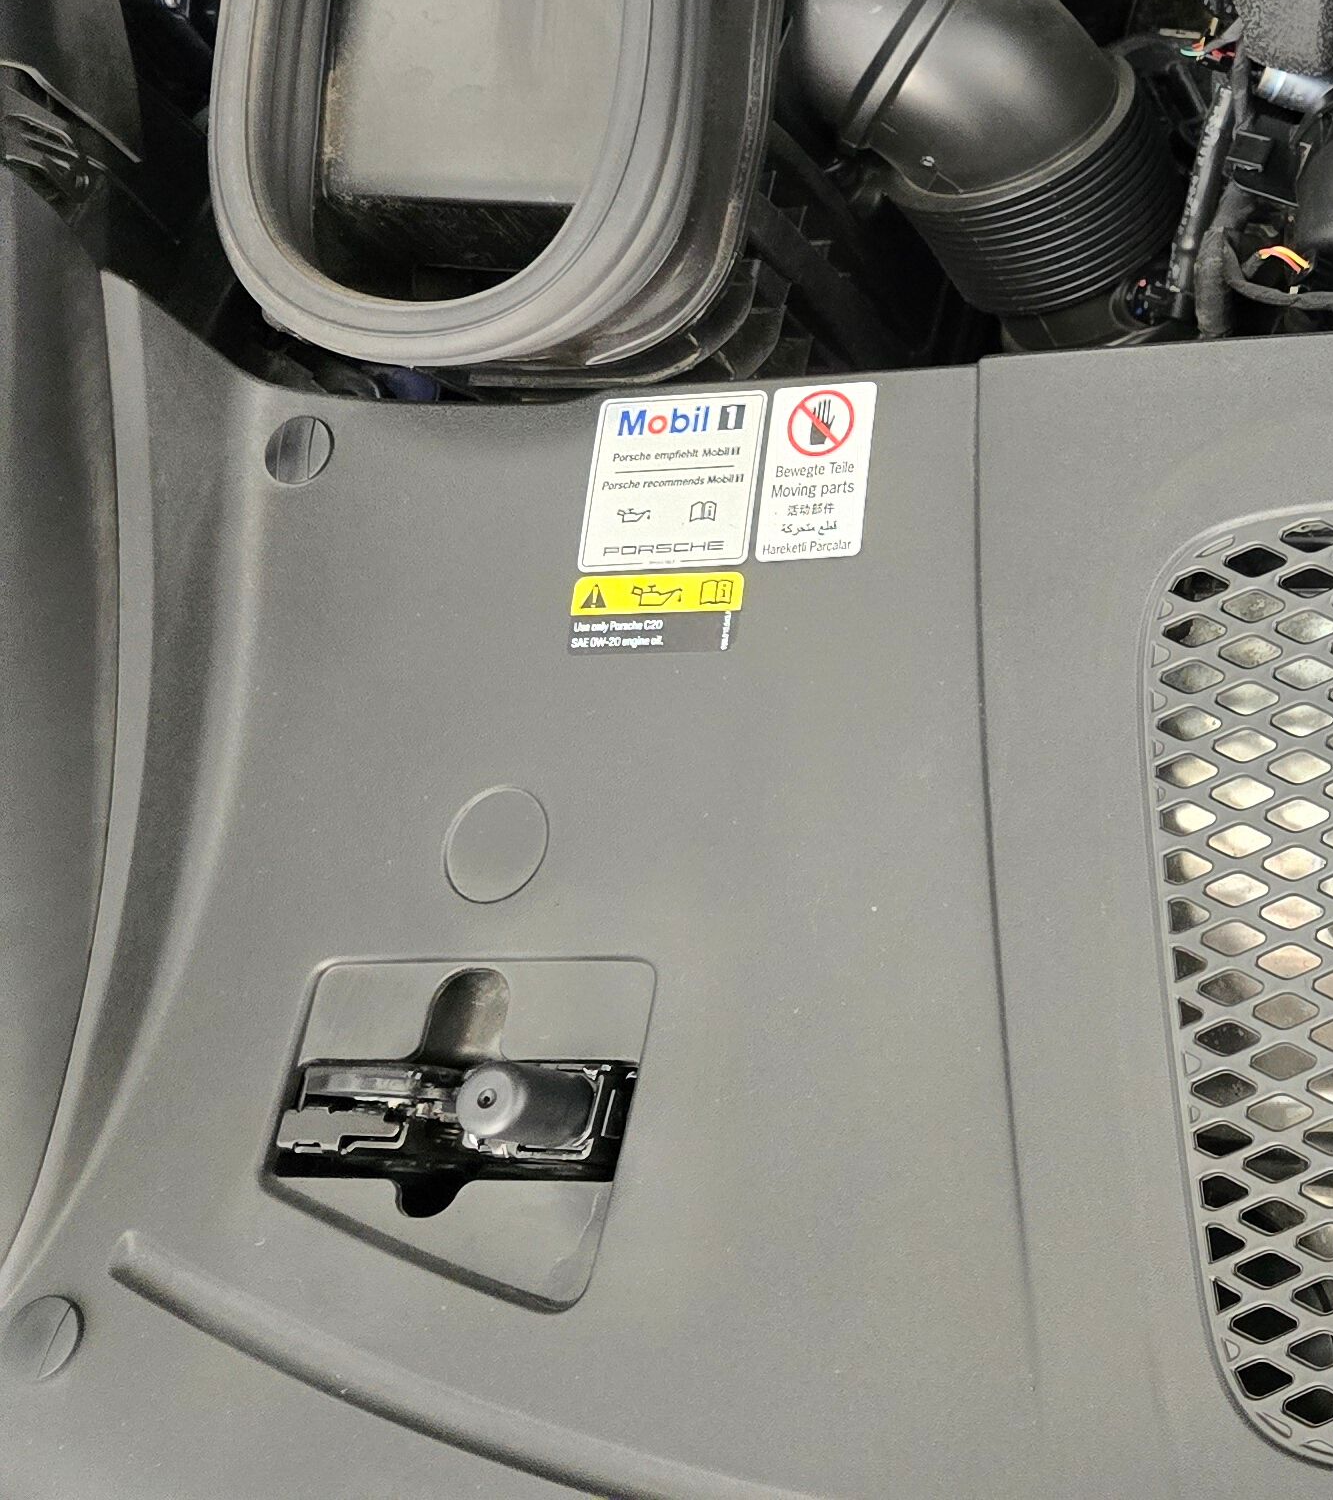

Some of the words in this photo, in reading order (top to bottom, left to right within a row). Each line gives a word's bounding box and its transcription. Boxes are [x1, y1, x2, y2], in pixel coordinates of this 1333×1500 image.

[617, 406, 710, 436] Mobil
[613, 451, 651, 462] Porsche
[654, 449, 698, 461] empfiehlt
[702, 448, 730, 457] Mobil
[776, 465, 825, 478] Bewegte
[830, 462, 855, 474] Teile
[602, 479, 640, 490] Porsche
[643, 476, 704, 488] recommends
[707, 475, 734, 484] Mobil
[771, 483, 816, 499] Moving
[821, 481, 855, 497] parts
[787, 503, 835, 516] 活动部件
[781, 524, 815, 536] متحركة
[818, 521, 837, 535] قطع
[603, 541, 724, 556] PORSCHE
[762, 542, 806, 555] Hareketli
[810, 540, 851, 552] Parçalar
[574, 622, 590, 632] Use
[591, 622, 609, 634] only
[609, 620, 643, 631] Porsche
[644, 620, 663, 630] C20
[571, 638, 589, 649] SAE
[590, 636, 621, 648] 0W-20
[621, 637, 650, 648] engine
[651, 636, 663, 646] oil.
